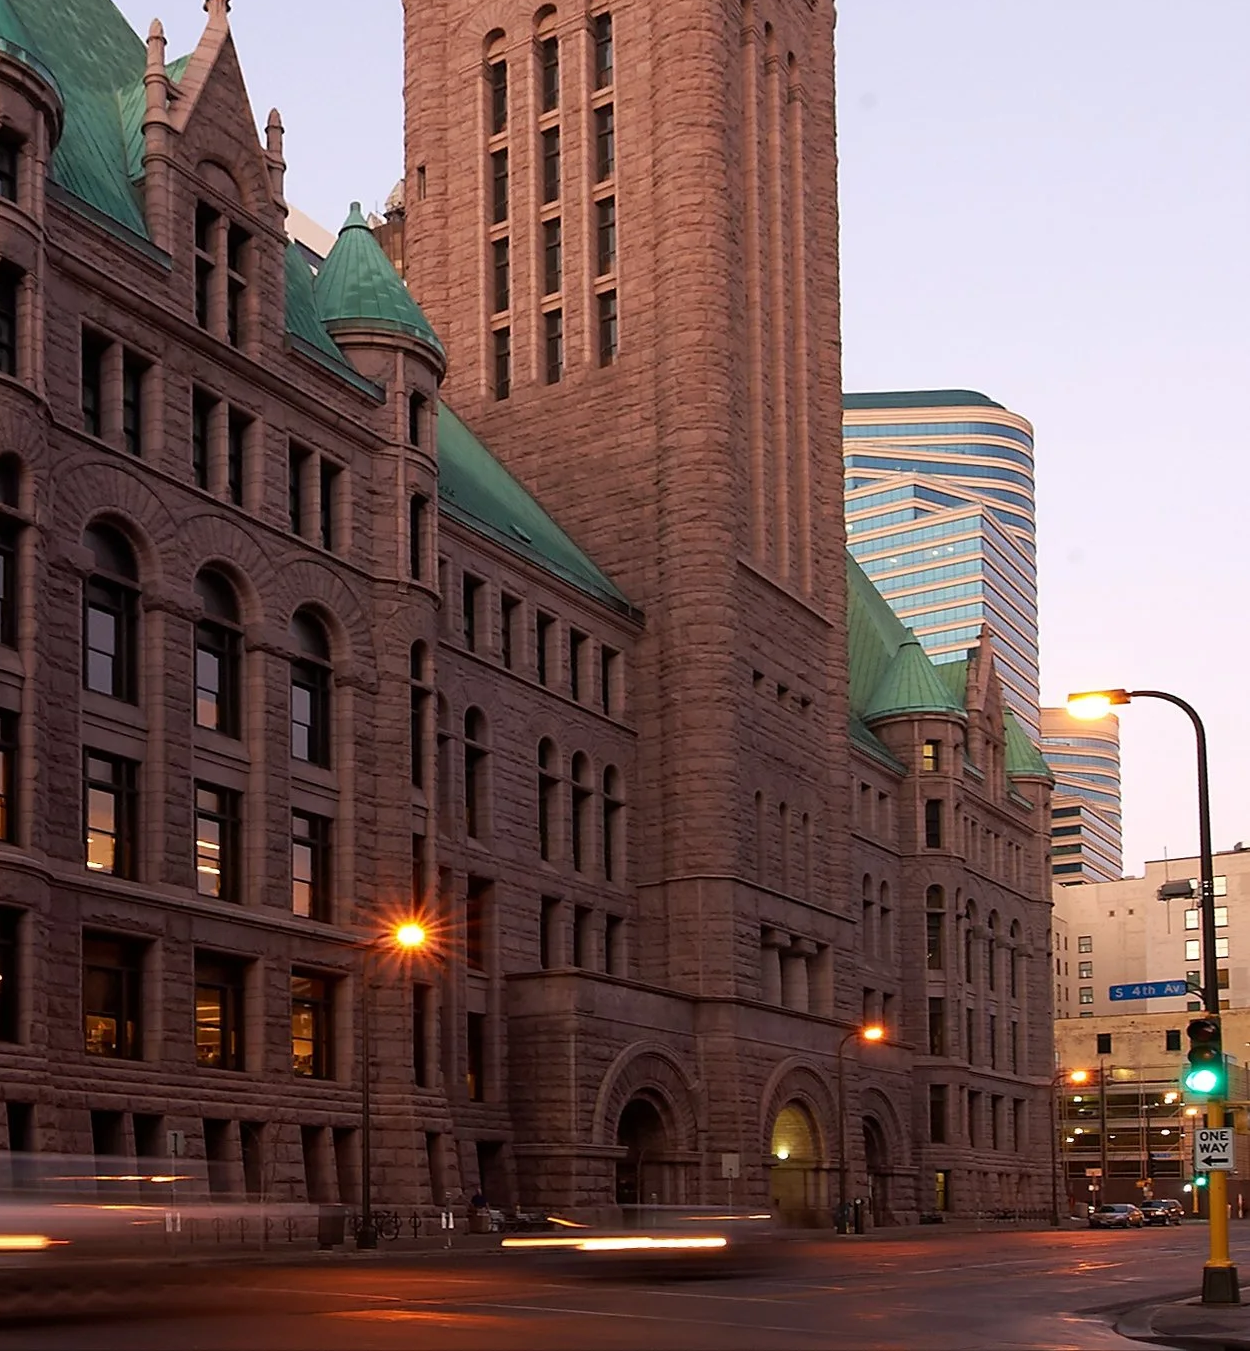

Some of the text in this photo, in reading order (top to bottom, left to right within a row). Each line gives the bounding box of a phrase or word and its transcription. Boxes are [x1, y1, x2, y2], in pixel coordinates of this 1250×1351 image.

[1115, 988, 1123, 998] S
[1132, 986, 1156, 996] 4th
[1164, 984, 1180, 994] Av
[1199, 1131, 1229, 1141] ONE
[1199, 1143, 1229, 1153] WAY
